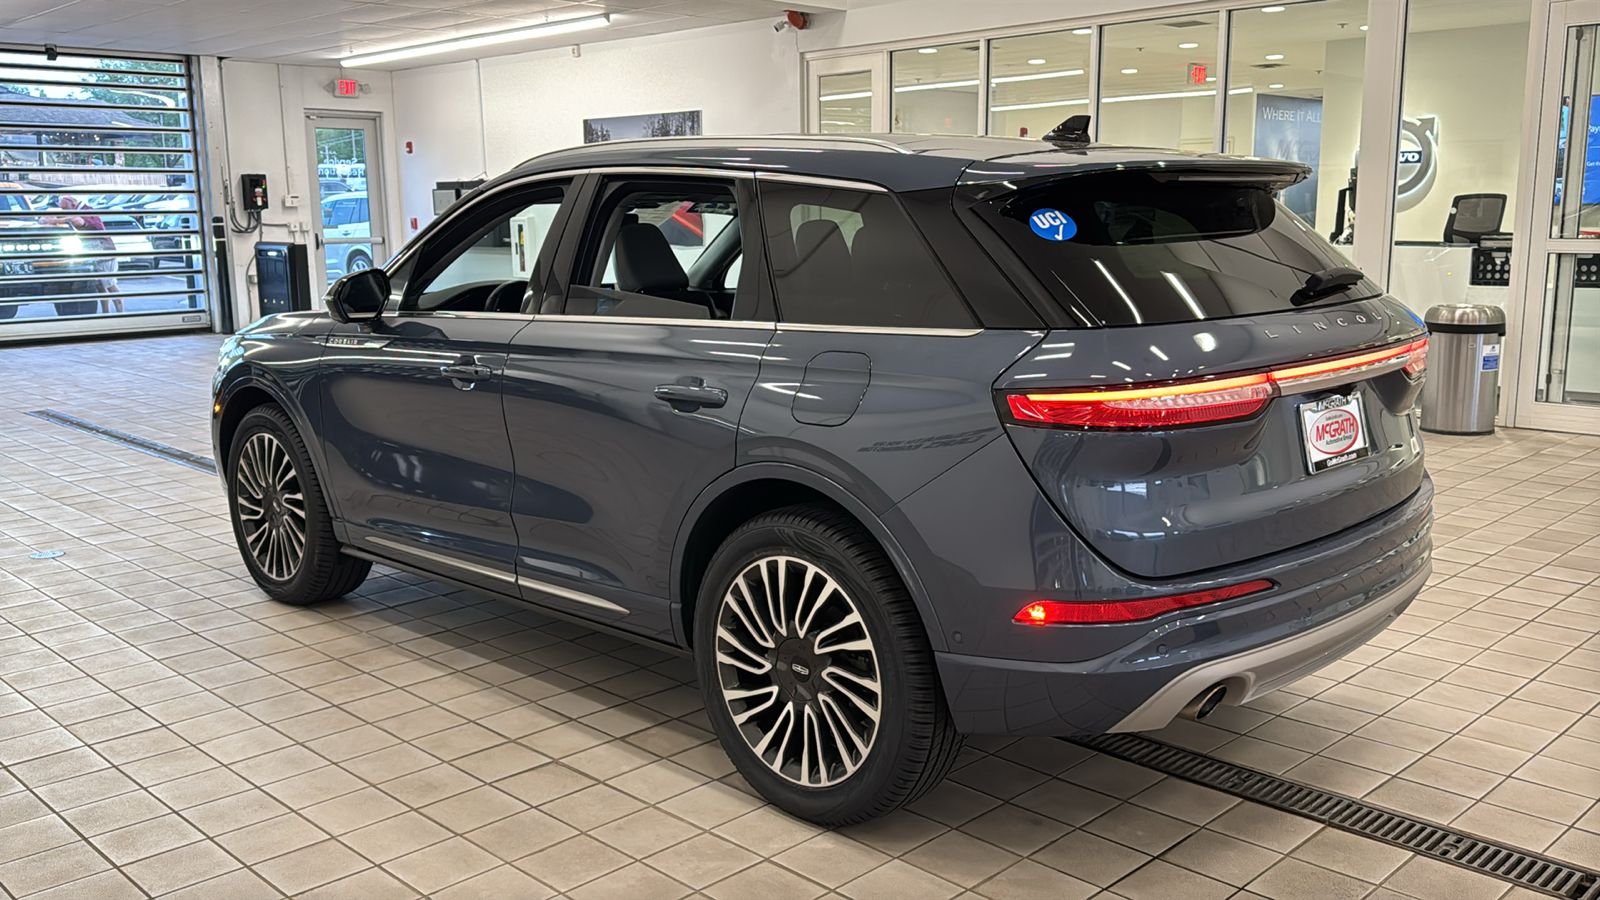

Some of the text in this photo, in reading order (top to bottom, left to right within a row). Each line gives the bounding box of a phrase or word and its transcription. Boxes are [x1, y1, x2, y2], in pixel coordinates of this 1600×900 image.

[338, 79, 357, 95] EXIT
[1031, 210, 1068, 229] UCI
[1264, 308, 1395, 339] LINCOLN
